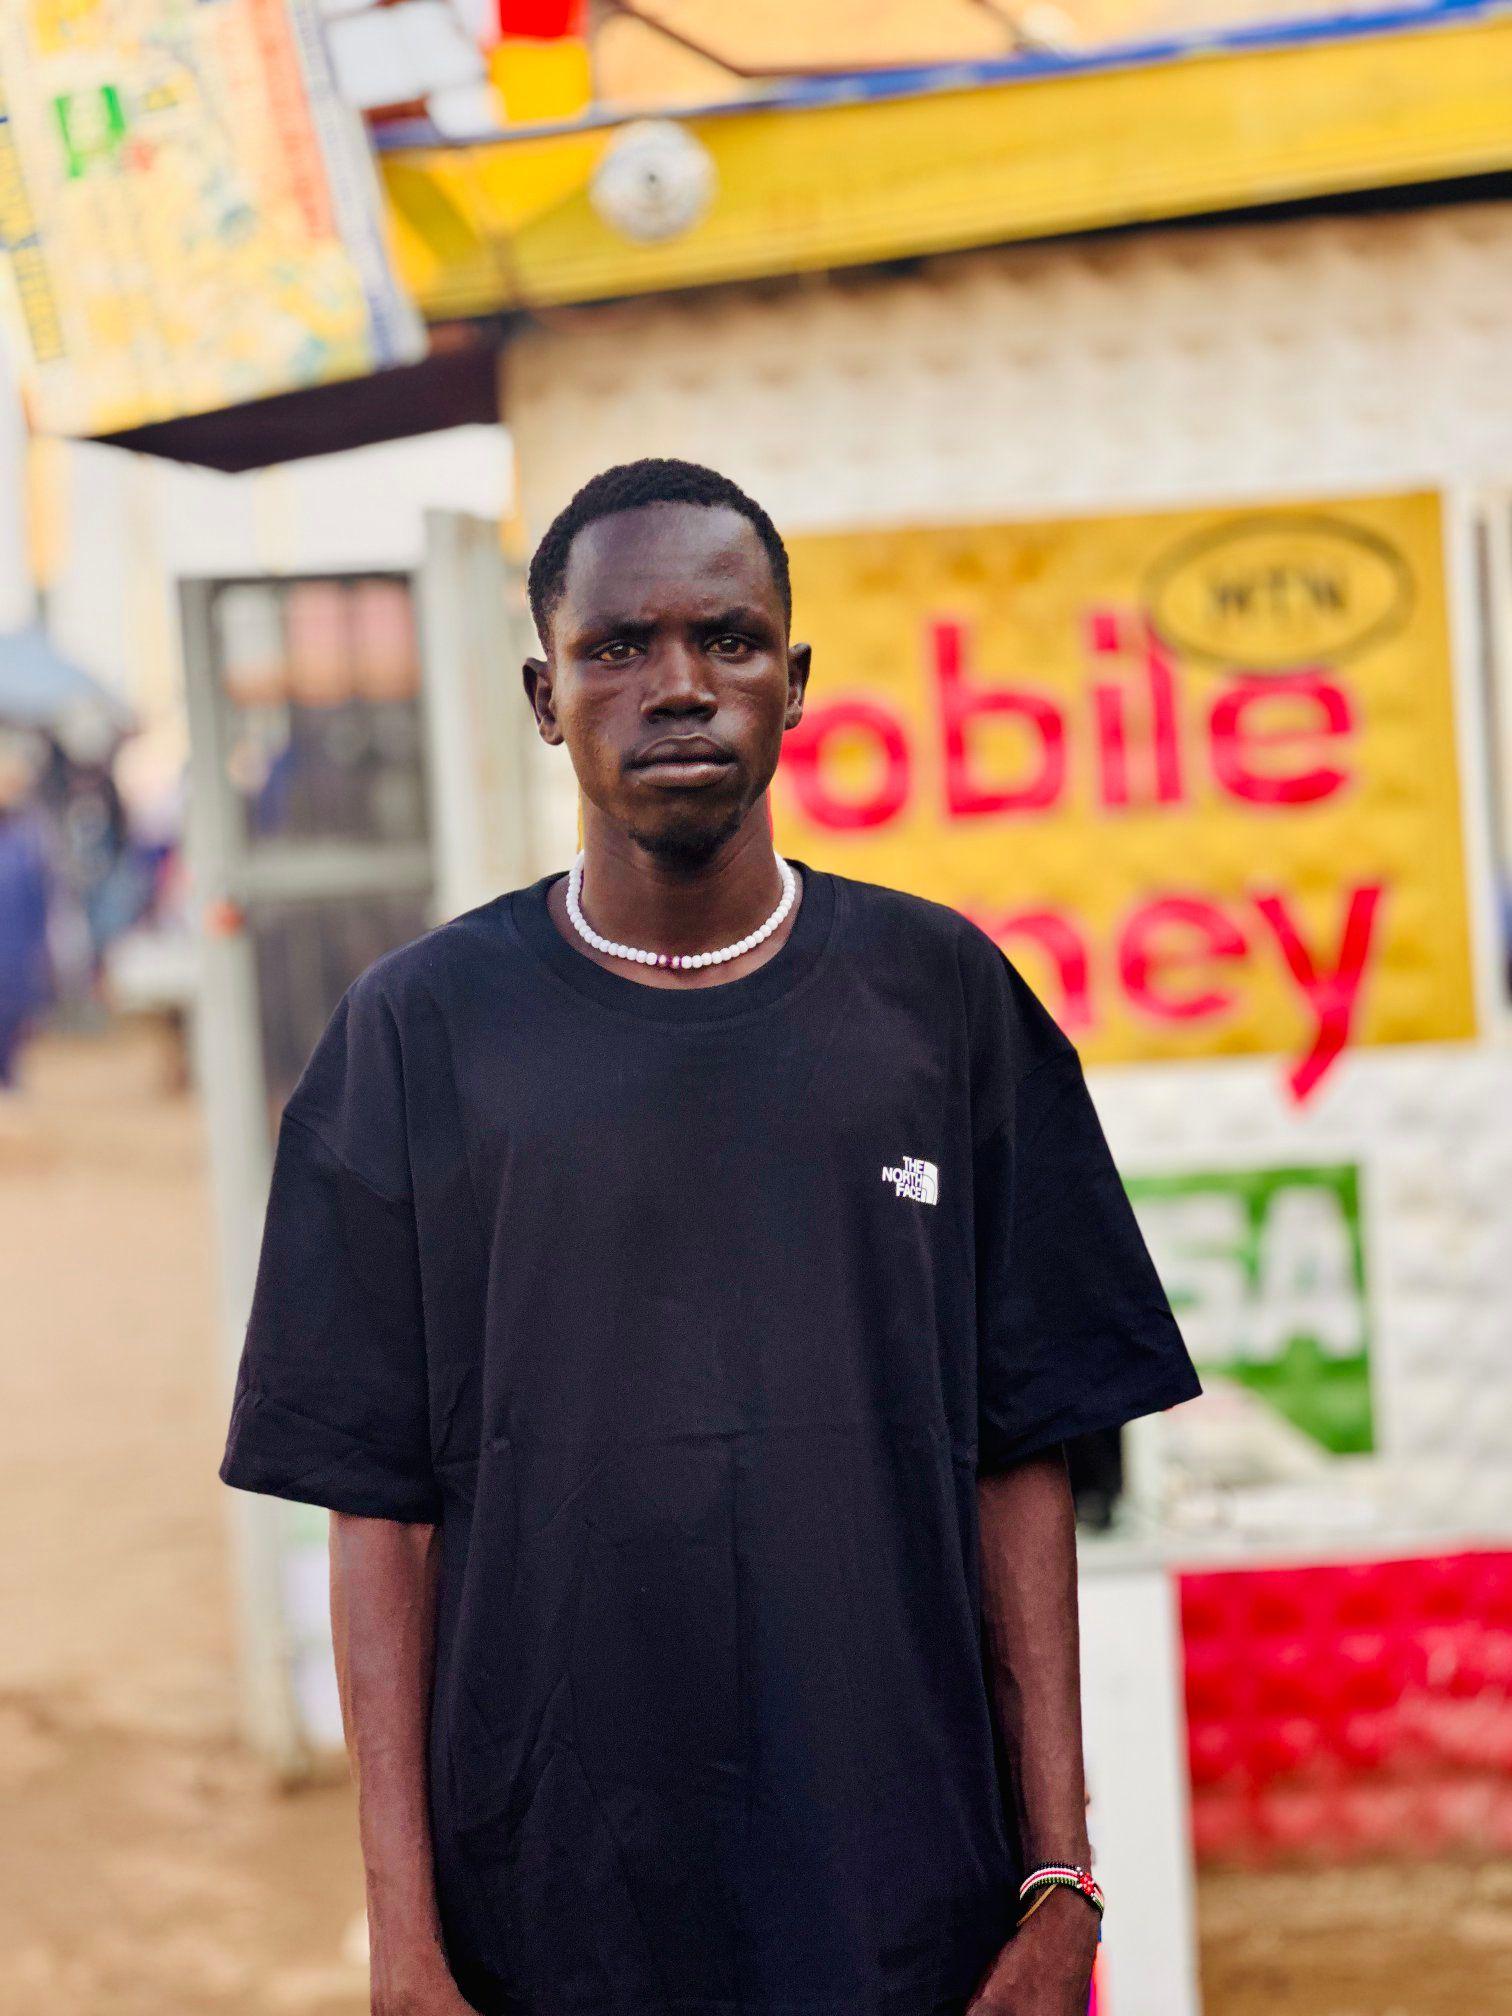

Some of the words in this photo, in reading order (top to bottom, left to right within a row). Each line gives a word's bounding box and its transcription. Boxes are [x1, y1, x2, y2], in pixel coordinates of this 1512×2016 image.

[770, 610, 1355, 836] obile
[960, 878, 1388, 1114] ney
[903, 1155, 925, 1173] THE
[882, 1166, 922, 1188] NORTH
[896, 1182, 922, 1202] FACE
